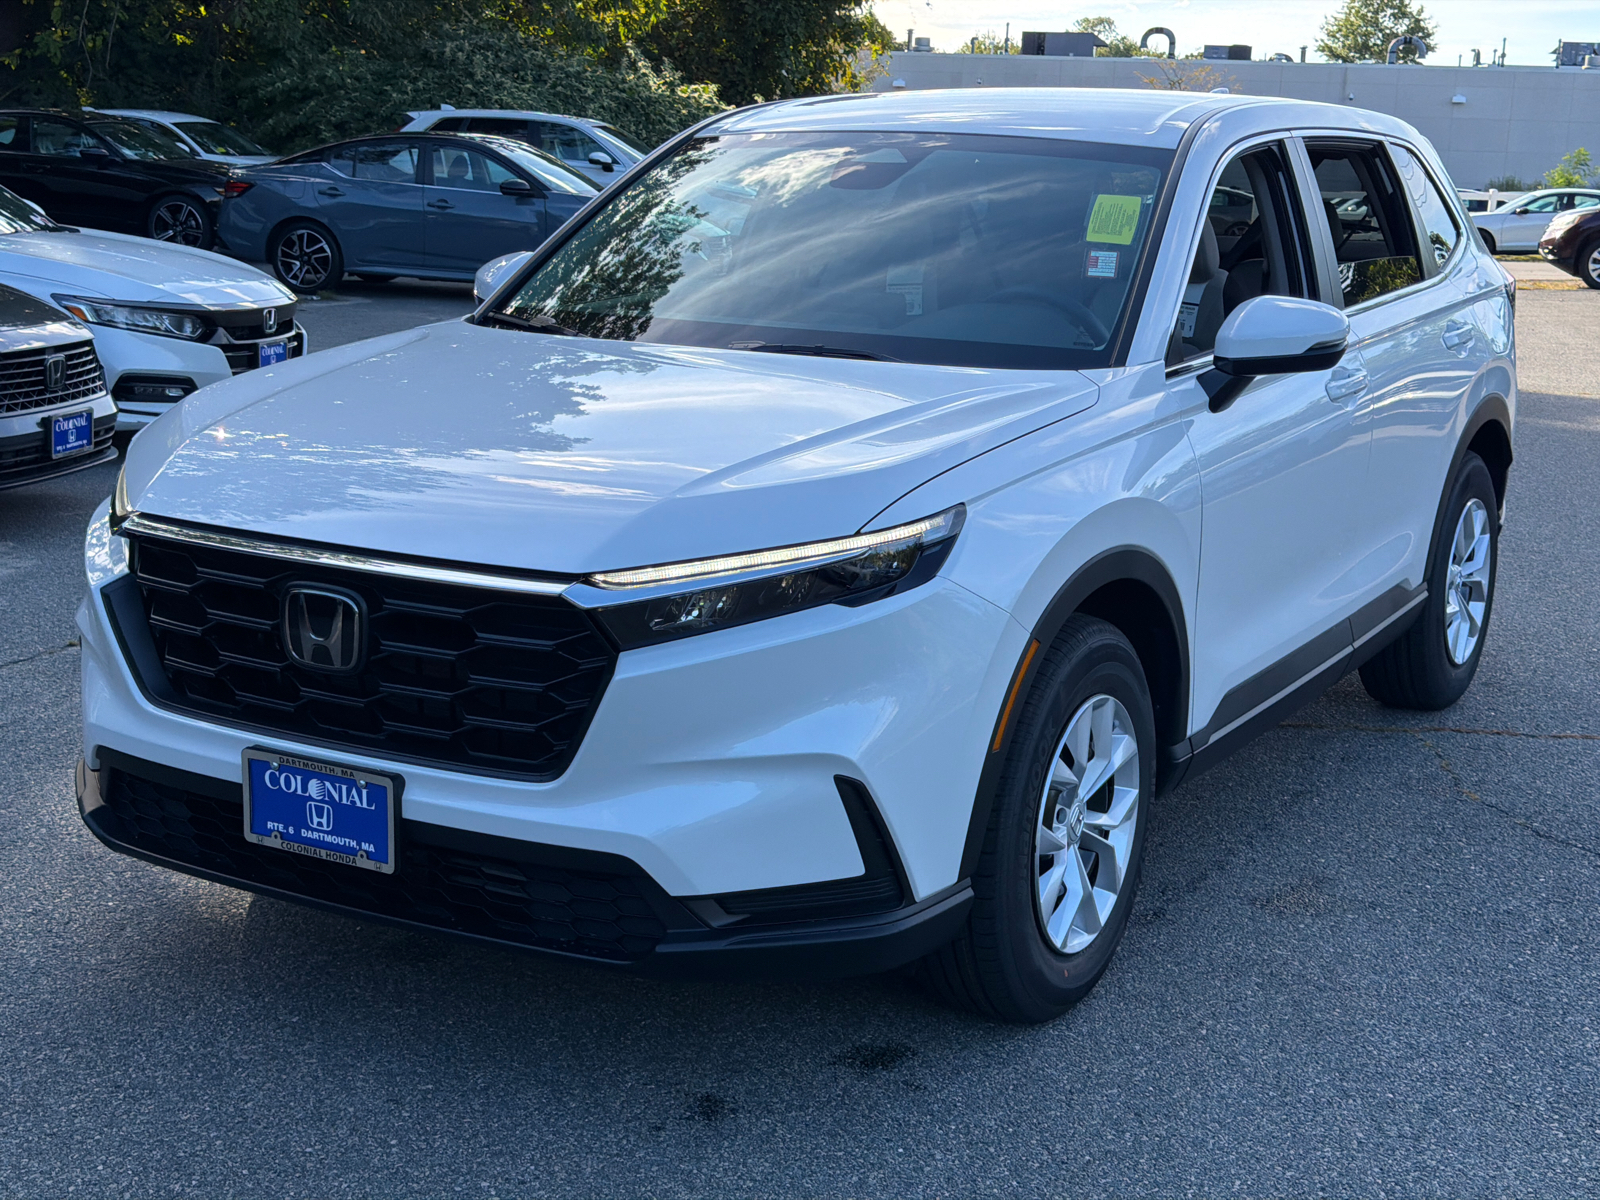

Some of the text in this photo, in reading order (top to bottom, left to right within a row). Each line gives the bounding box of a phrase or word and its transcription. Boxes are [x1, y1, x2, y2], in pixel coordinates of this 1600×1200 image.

[279, 756, 356, 779] DARTMOUTH, MA
[264, 769, 376, 811] COLONIAL
[267, 821, 376, 853] RTE. 6 DARTMOUTH, MA
[280, 841, 358, 866] COLONIAL HONDA
